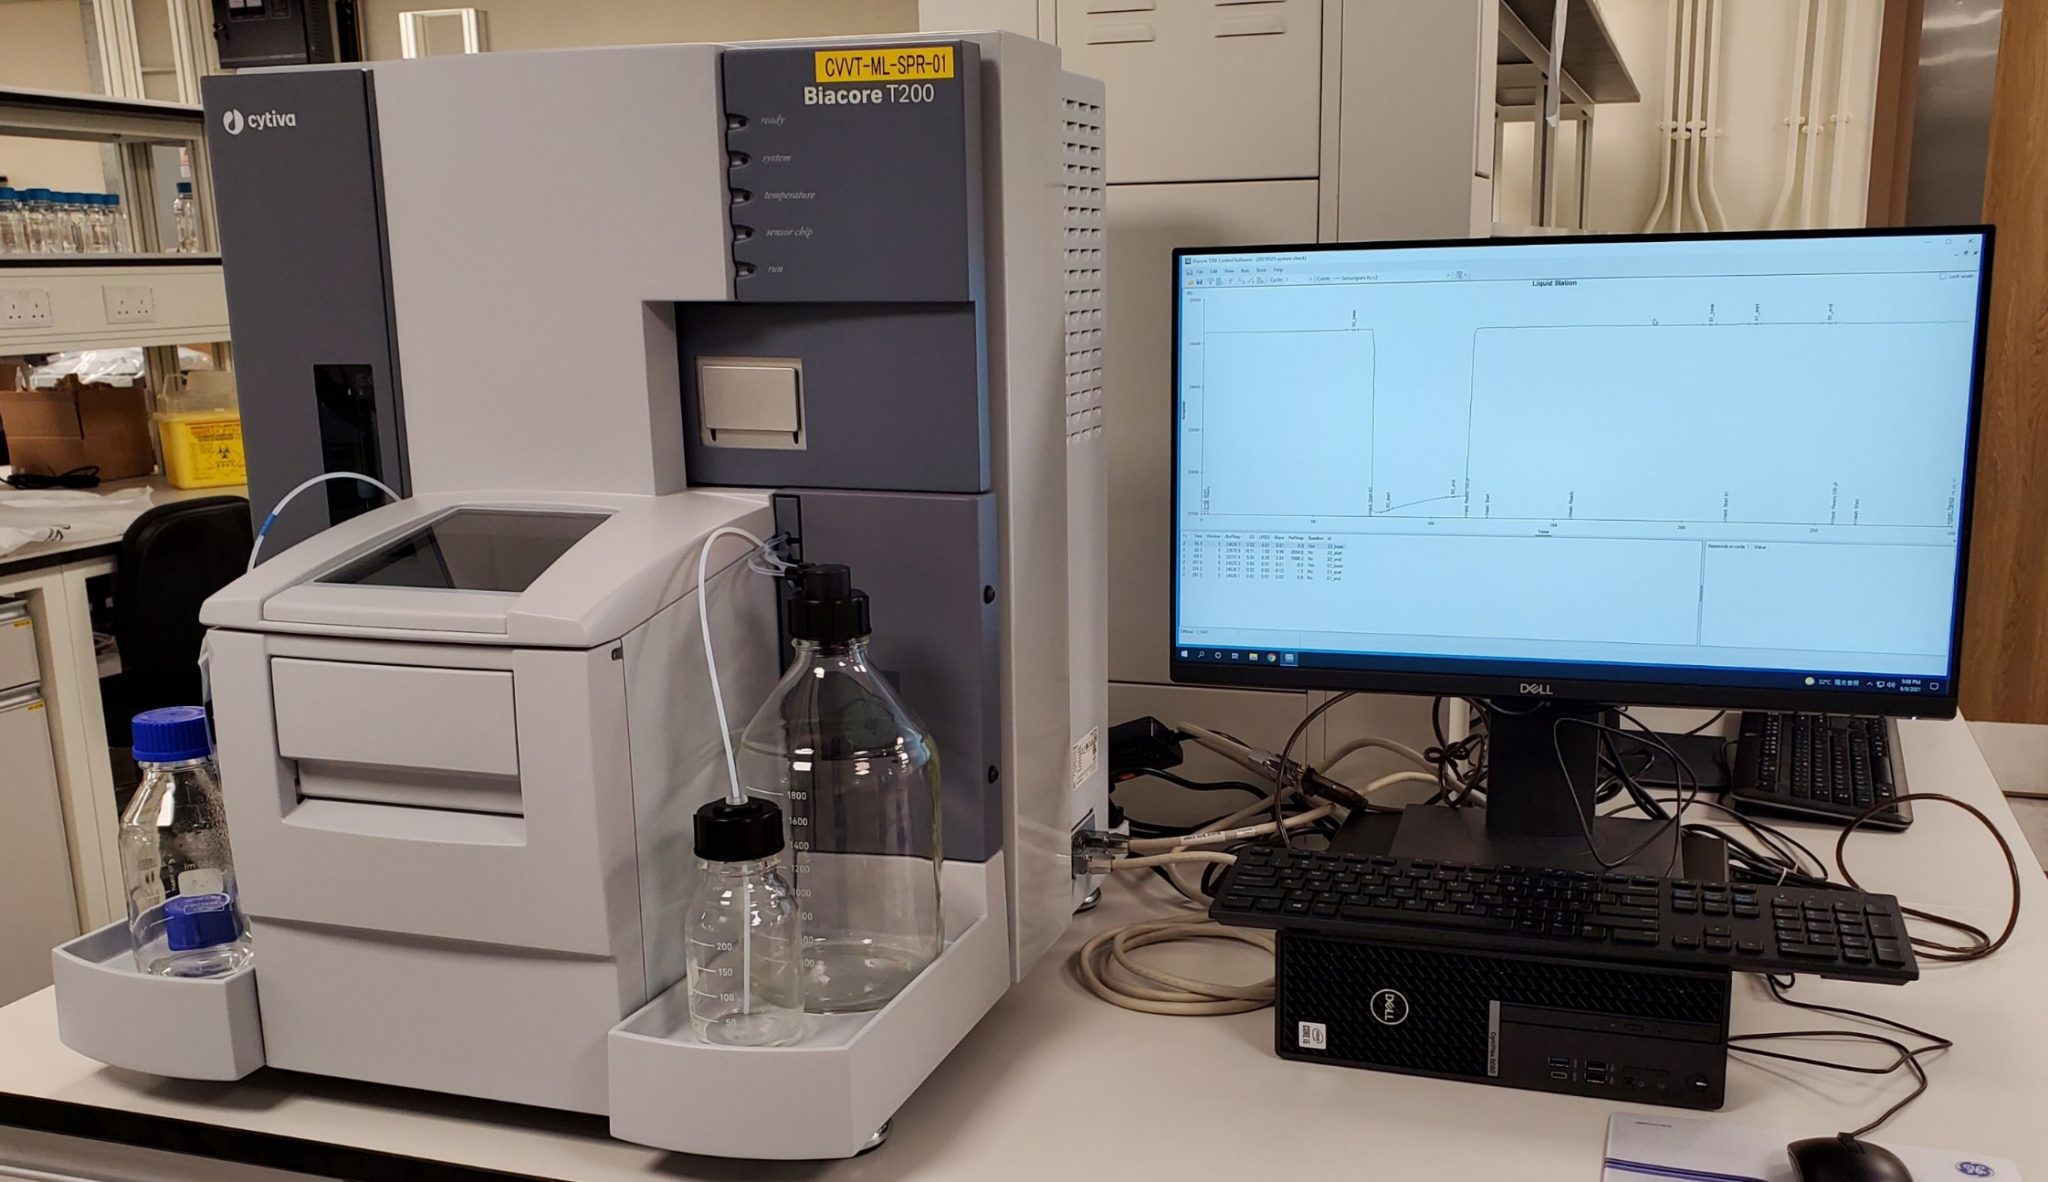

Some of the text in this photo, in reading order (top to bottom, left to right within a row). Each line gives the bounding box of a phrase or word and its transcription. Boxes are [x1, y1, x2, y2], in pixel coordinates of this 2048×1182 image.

[825, 54, 946, 77] CVVT-ML-SPR-01
[803, 84, 935, 105] Biacore T200
[247, 110, 297, 131] cytiva
[760, 114, 786, 127] ready
[762, 153, 791, 164] system
[764, 190, 816, 202] temperature
[765, 226, 814, 238] sensor chip
[767, 264, 784, 274] run
[1532, 279, 1578, 288] Liquid Station
[1520, 683, 1554, 695] DELL
[787, 791, 807, 800] 1800
[788, 816, 808, 826] 1600
[790, 840, 810, 850] 1400
[791, 864, 810, 873] 1200
[792, 888, 811, 897] 1000
[802, 912, 813, 920] 00
[801, 936, 814, 944] 00
[716, 943, 732, 951] 200
[803, 958, 815, 967] 00
[718, 968, 733, 976] 150
[720, 993, 735, 1002] 100
[1384, 993, 1395, 1021] DELL
[1302, 1025, 1310, 1038] CORE
